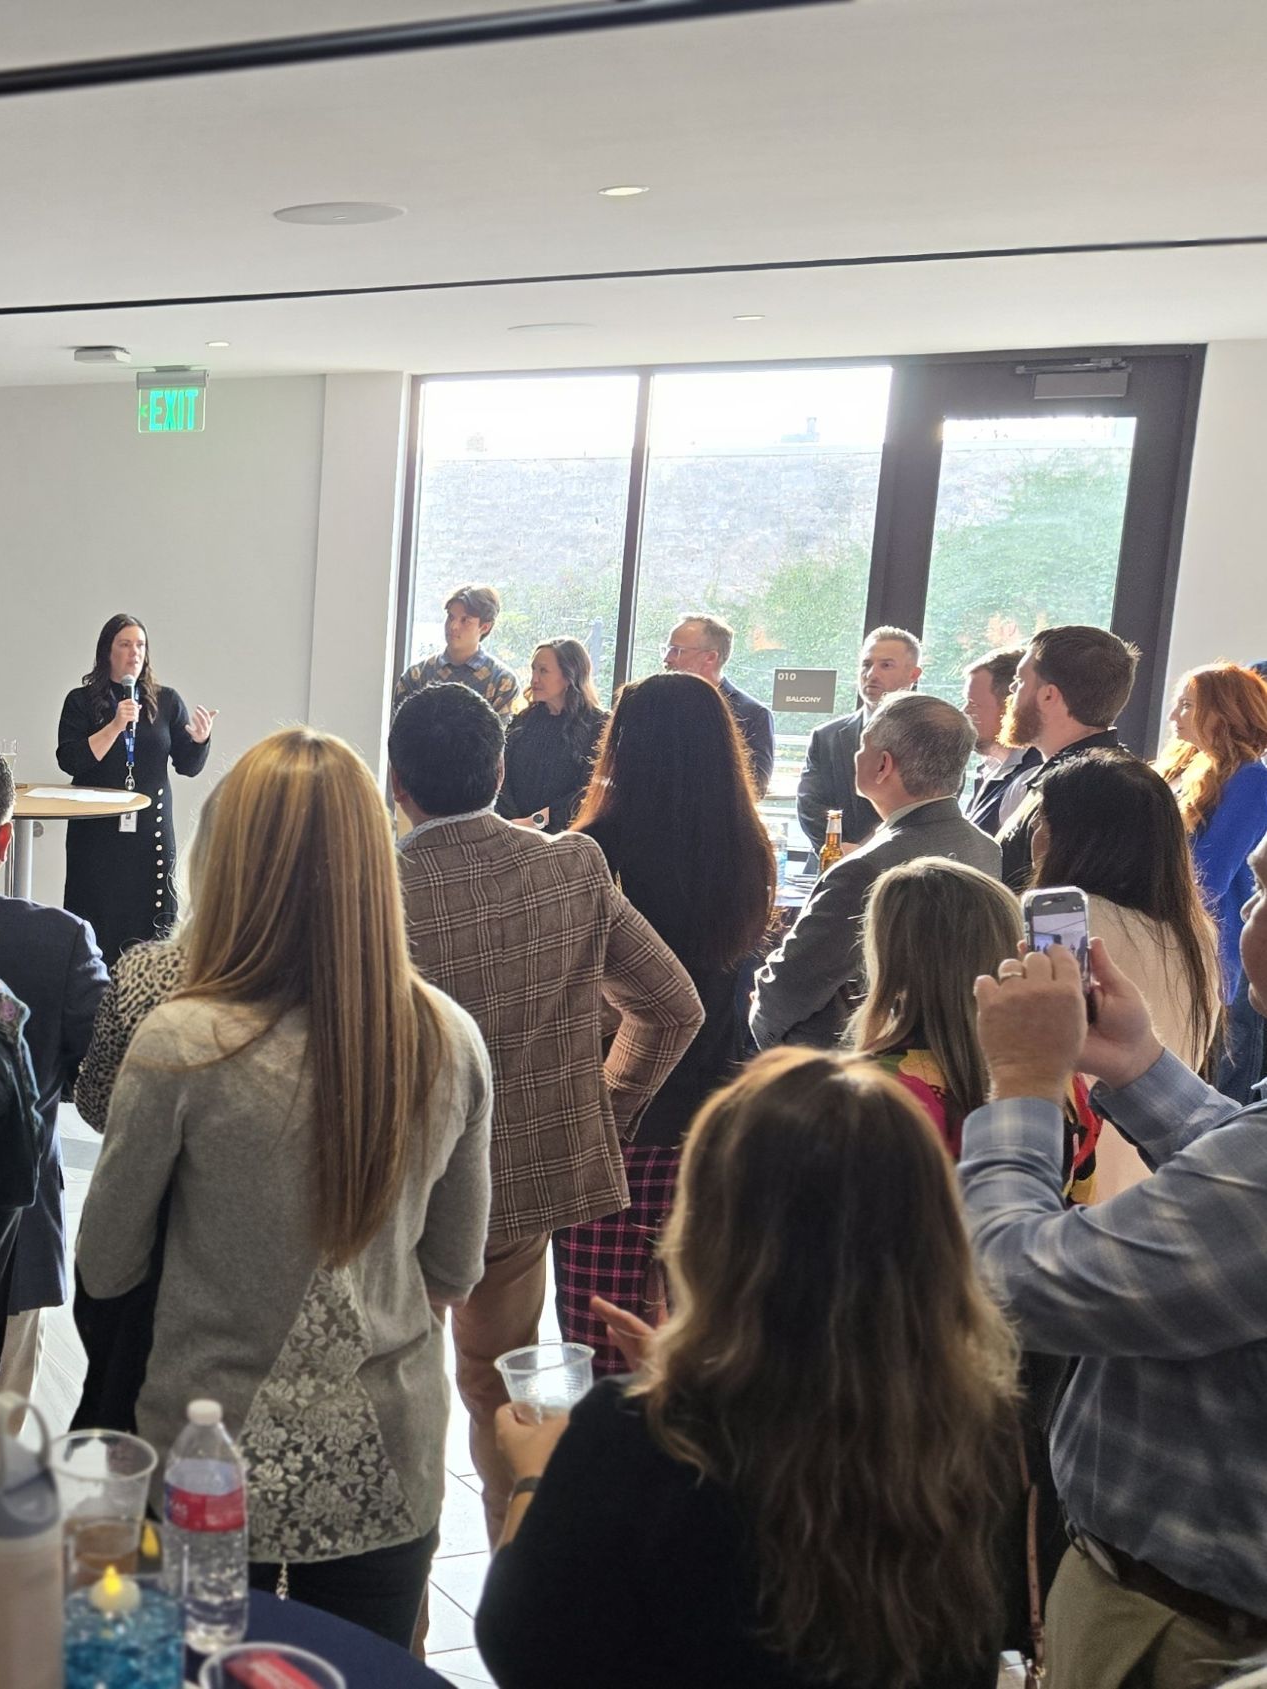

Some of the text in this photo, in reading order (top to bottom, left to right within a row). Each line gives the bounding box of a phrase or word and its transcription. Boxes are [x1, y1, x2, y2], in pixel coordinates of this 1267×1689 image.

[149, 389, 199, 431] EXIT
[777, 672, 797, 681] 010
[785, 695, 822, 703] BALCONY
